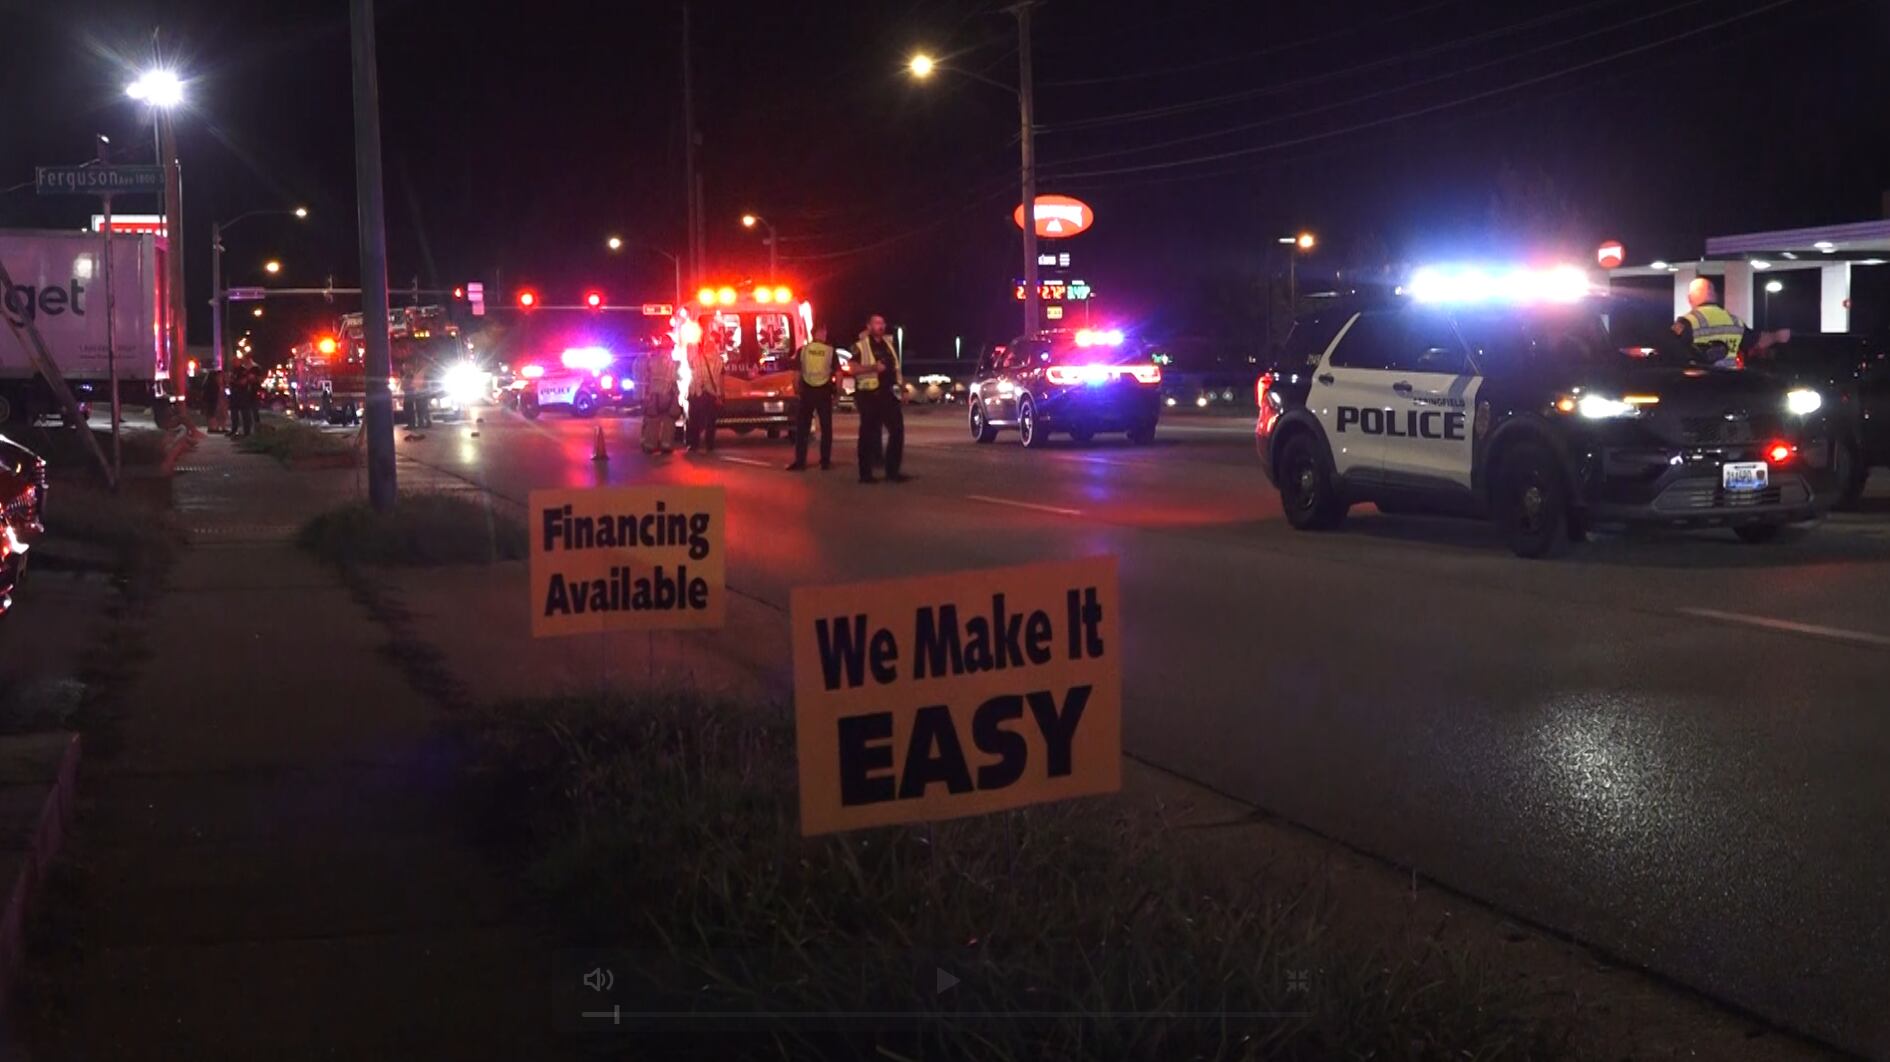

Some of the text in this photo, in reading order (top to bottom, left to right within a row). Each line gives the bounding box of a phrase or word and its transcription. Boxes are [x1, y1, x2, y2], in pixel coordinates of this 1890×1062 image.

[39, 169, 118, 191] Ferguson
[723, 362, 779, 372] MBULANCE
[1337, 406, 1466, 440] POLICE
[543, 501, 710, 560] Financing
[545, 565, 709, 616] Available
[815, 587, 1104, 690] We Make It
[837, 685, 1093, 807] EASY
